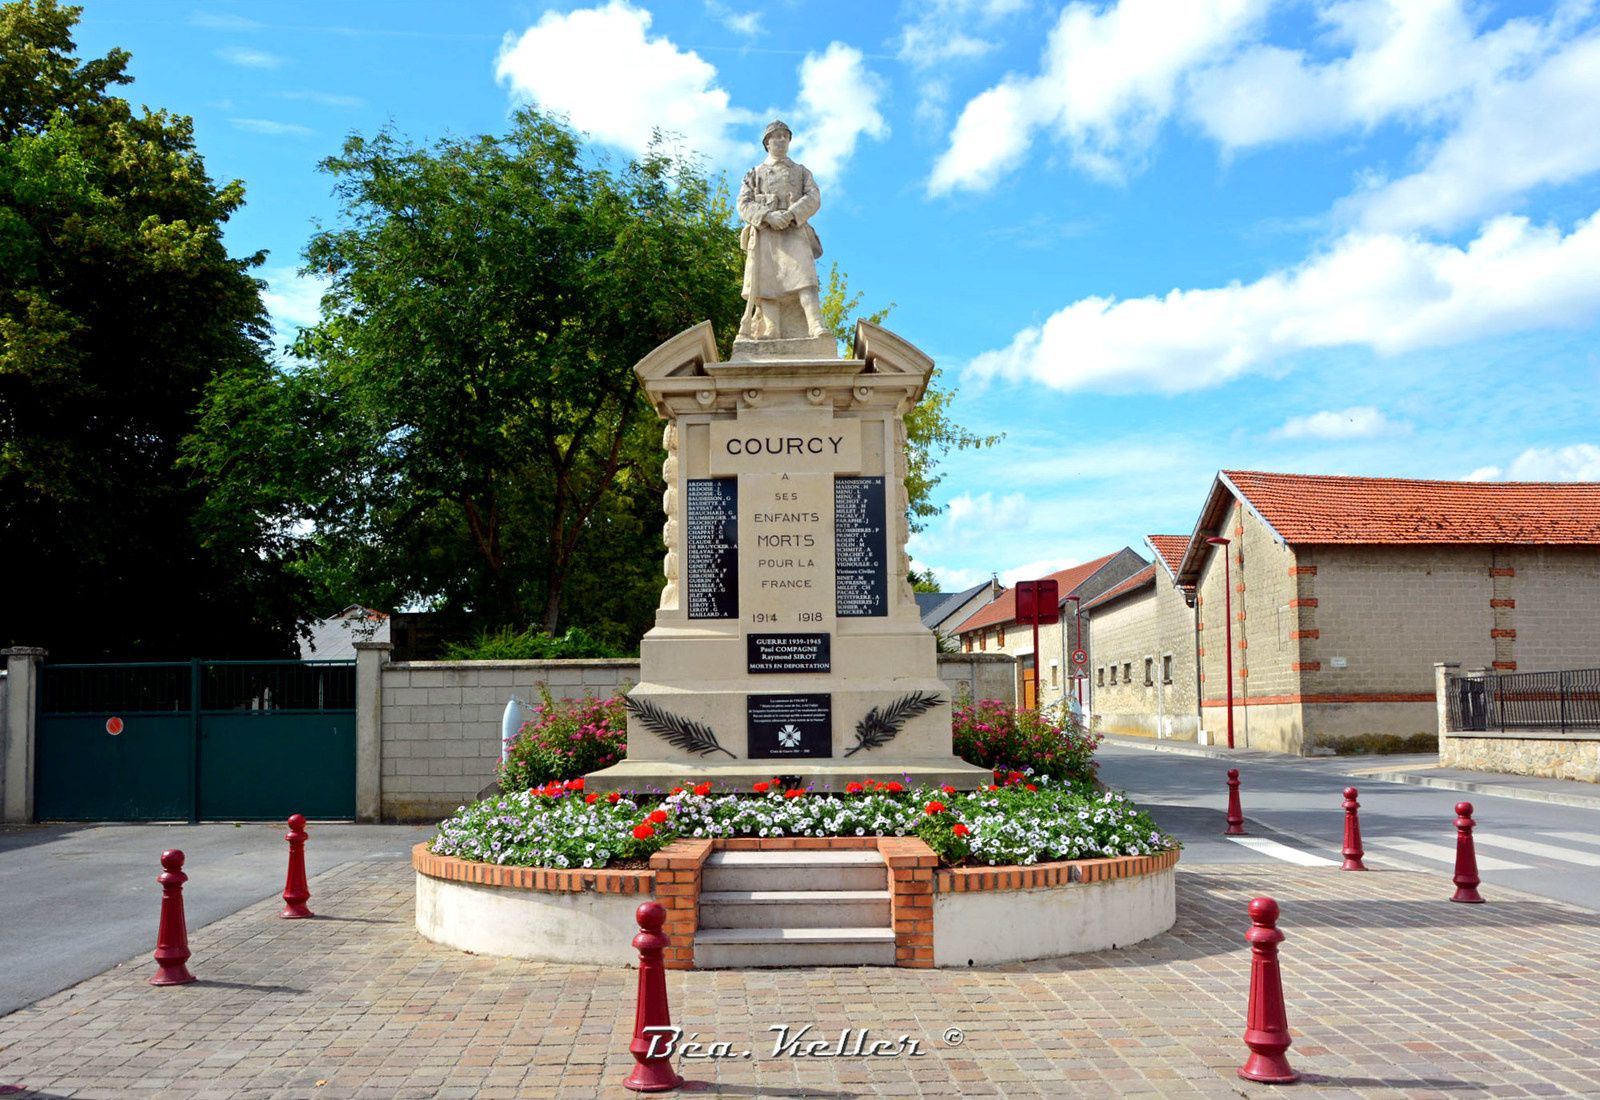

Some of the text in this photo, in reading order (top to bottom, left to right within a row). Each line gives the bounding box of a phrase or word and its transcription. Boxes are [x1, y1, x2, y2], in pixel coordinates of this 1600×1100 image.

[726, 436, 843, 455] COURCY
[775, 492, 798, 500] SES
[754, 512, 820, 523] ENFANTS
[758, 534, 814, 547] MORTS
[758, 559, 814, 568] POUR LA
[761, 580, 812, 588] FRANCE
[752, 612, 823, 622] 1914 1918
